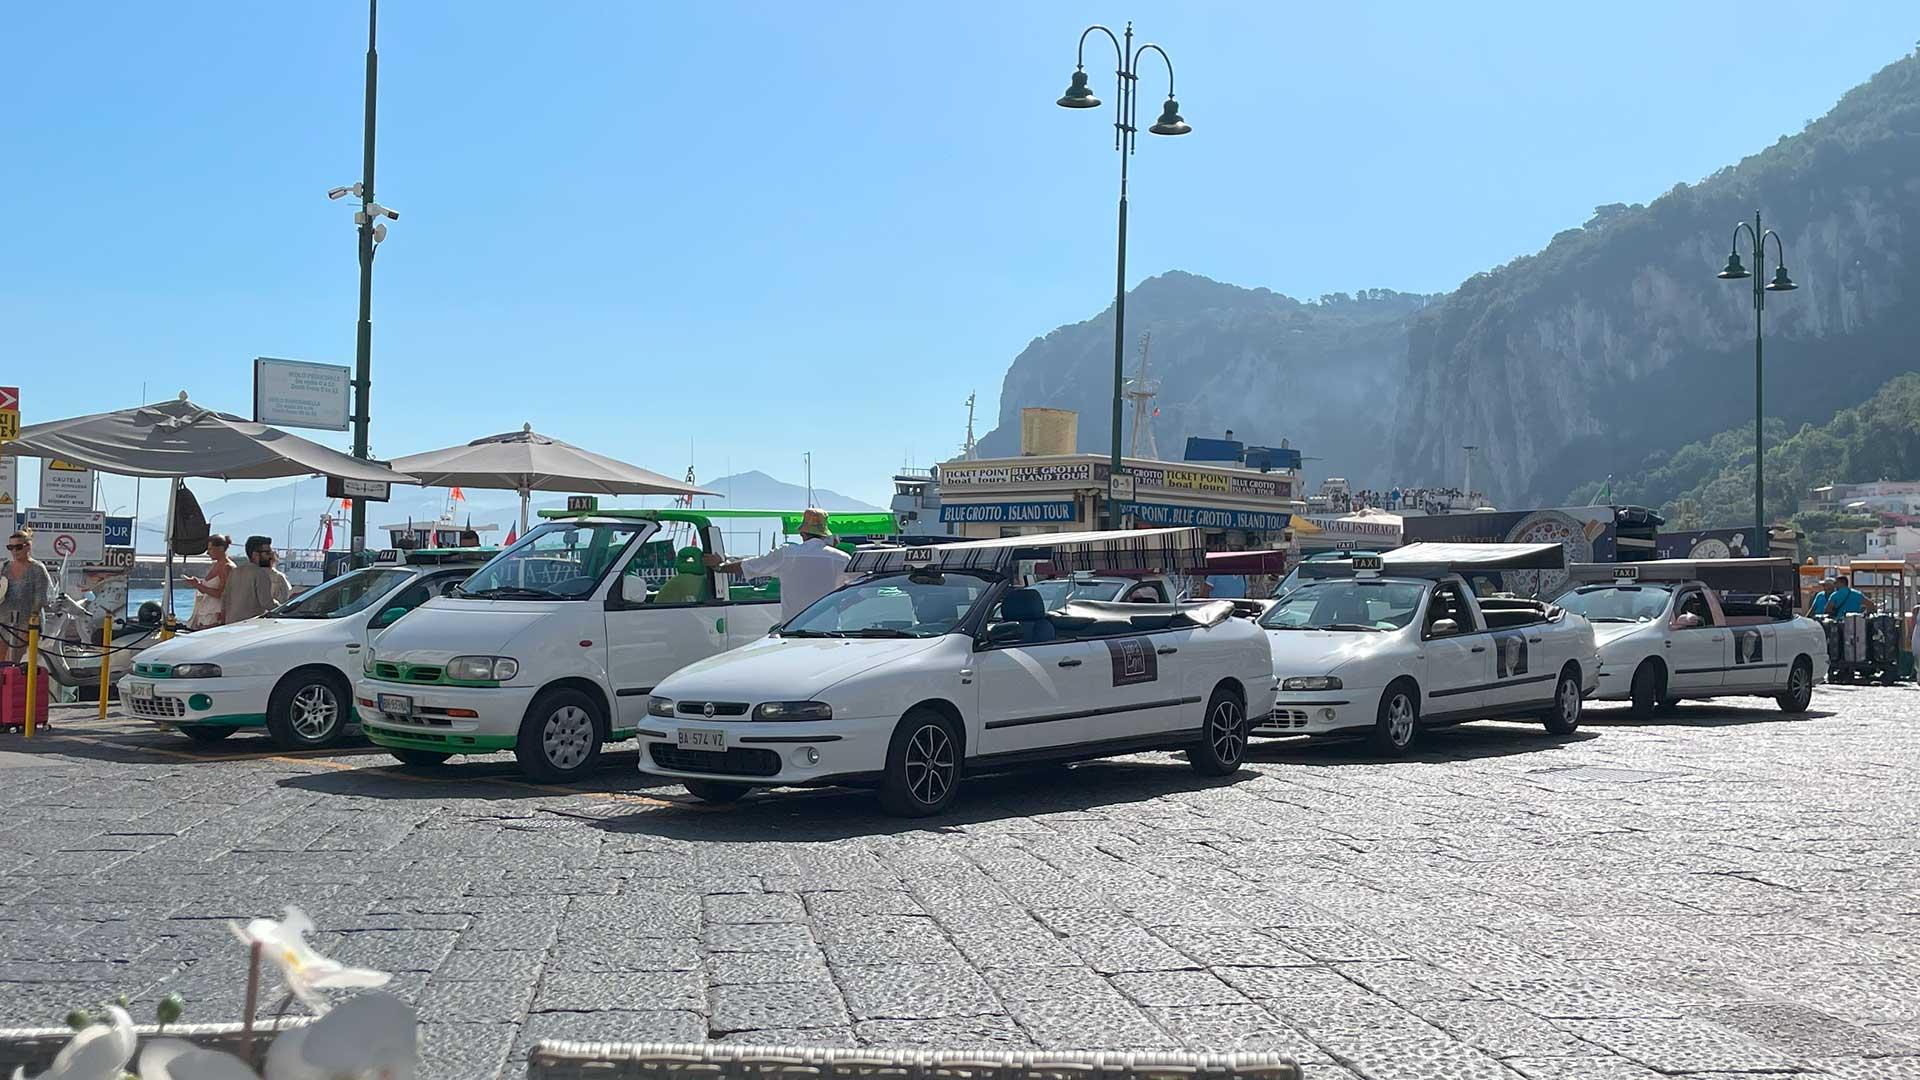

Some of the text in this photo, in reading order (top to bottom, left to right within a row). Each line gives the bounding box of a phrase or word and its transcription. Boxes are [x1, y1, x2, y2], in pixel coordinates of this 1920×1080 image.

[946, 469, 1009, 479] TICKET POINT
[1012, 464, 1088, 476] BLUE GROTTO
[1133, 469, 1163, 478] GROTTO
[947, 476, 1006, 485] boat tours
[1012, 472, 1088, 482] ISLAND TOUR
[1142, 477, 1163, 486] TOUR
[1166, 470, 1228, 484] TICKET POINT
[1168, 479, 1226, 492] boat tours
[1232, 478, 1275, 490] BLUE GROTTO
[1232, 486, 1275, 497] ISLAND TOUR
[569, 498, 592, 510] TAXI
[944, 504, 1070, 521] BLUE GROTTO ISLAND TOUR
[1141, 505, 1169, 523] POINT
[1173, 508, 1195, 524] BLUE
[1197, 511, 1232, 527] GROTTO
[1237, 513, 1264, 528] ISLAND
[28, 521, 52, 529] DIVIETO
[62, 522, 102, 531] BALNEAZIONE
[104, 525, 129, 538] OUR
[1358, 522, 1397, 536] STORAGE
[104, 548, 134, 567] ffice
[380, 551, 396, 560] TAXI
[907, 549, 930, 560] TAXI
[1354, 559, 1378, 568] TAXI
[1613, 568, 1635, 578] TAXI
[678, 732, 724, 746] BA 574 VZ
